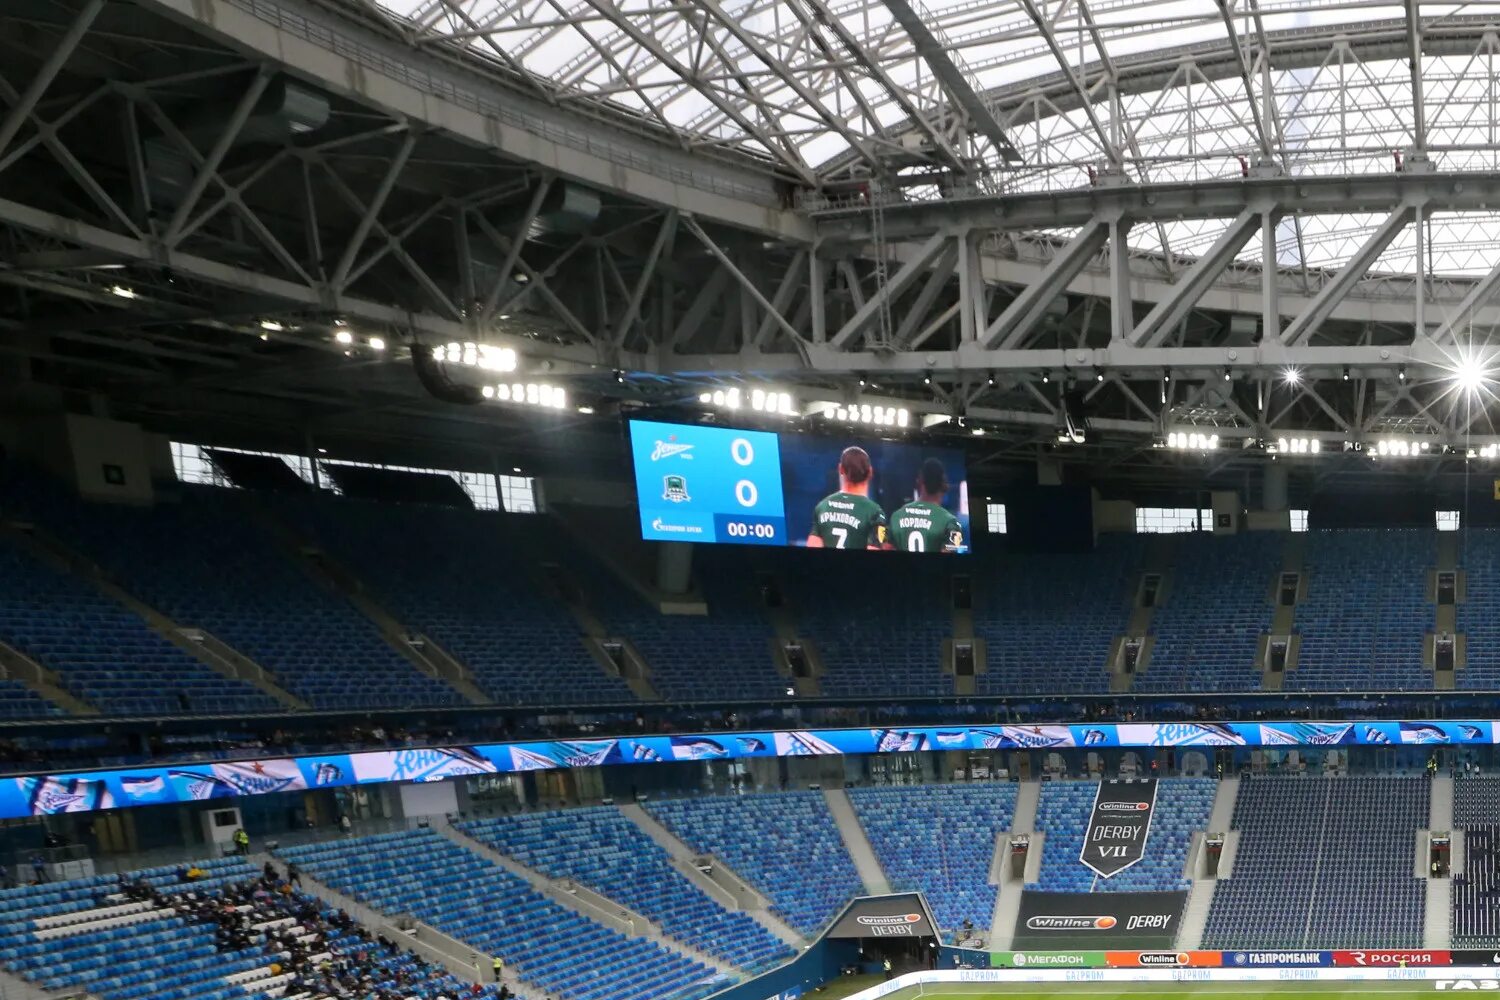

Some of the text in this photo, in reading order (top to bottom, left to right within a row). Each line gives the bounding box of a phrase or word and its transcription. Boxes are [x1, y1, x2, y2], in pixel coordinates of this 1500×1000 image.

[732, 438, 753, 466] 0
[736, 479, 758, 507] 0
[727, 522, 774, 538] 00:00
[831, 527, 847, 549] 7
[1092, 826, 1142, 841] DERBY
[1098, 846, 1128, 857] VII
[1126, 914, 1172, 930] DERBY
[871, 924, 914, 936] DERBY
[1249, 952, 1321, 964] ГАЗПРОМБАНК
[1371, 953, 1431, 963] РОССИЯ
